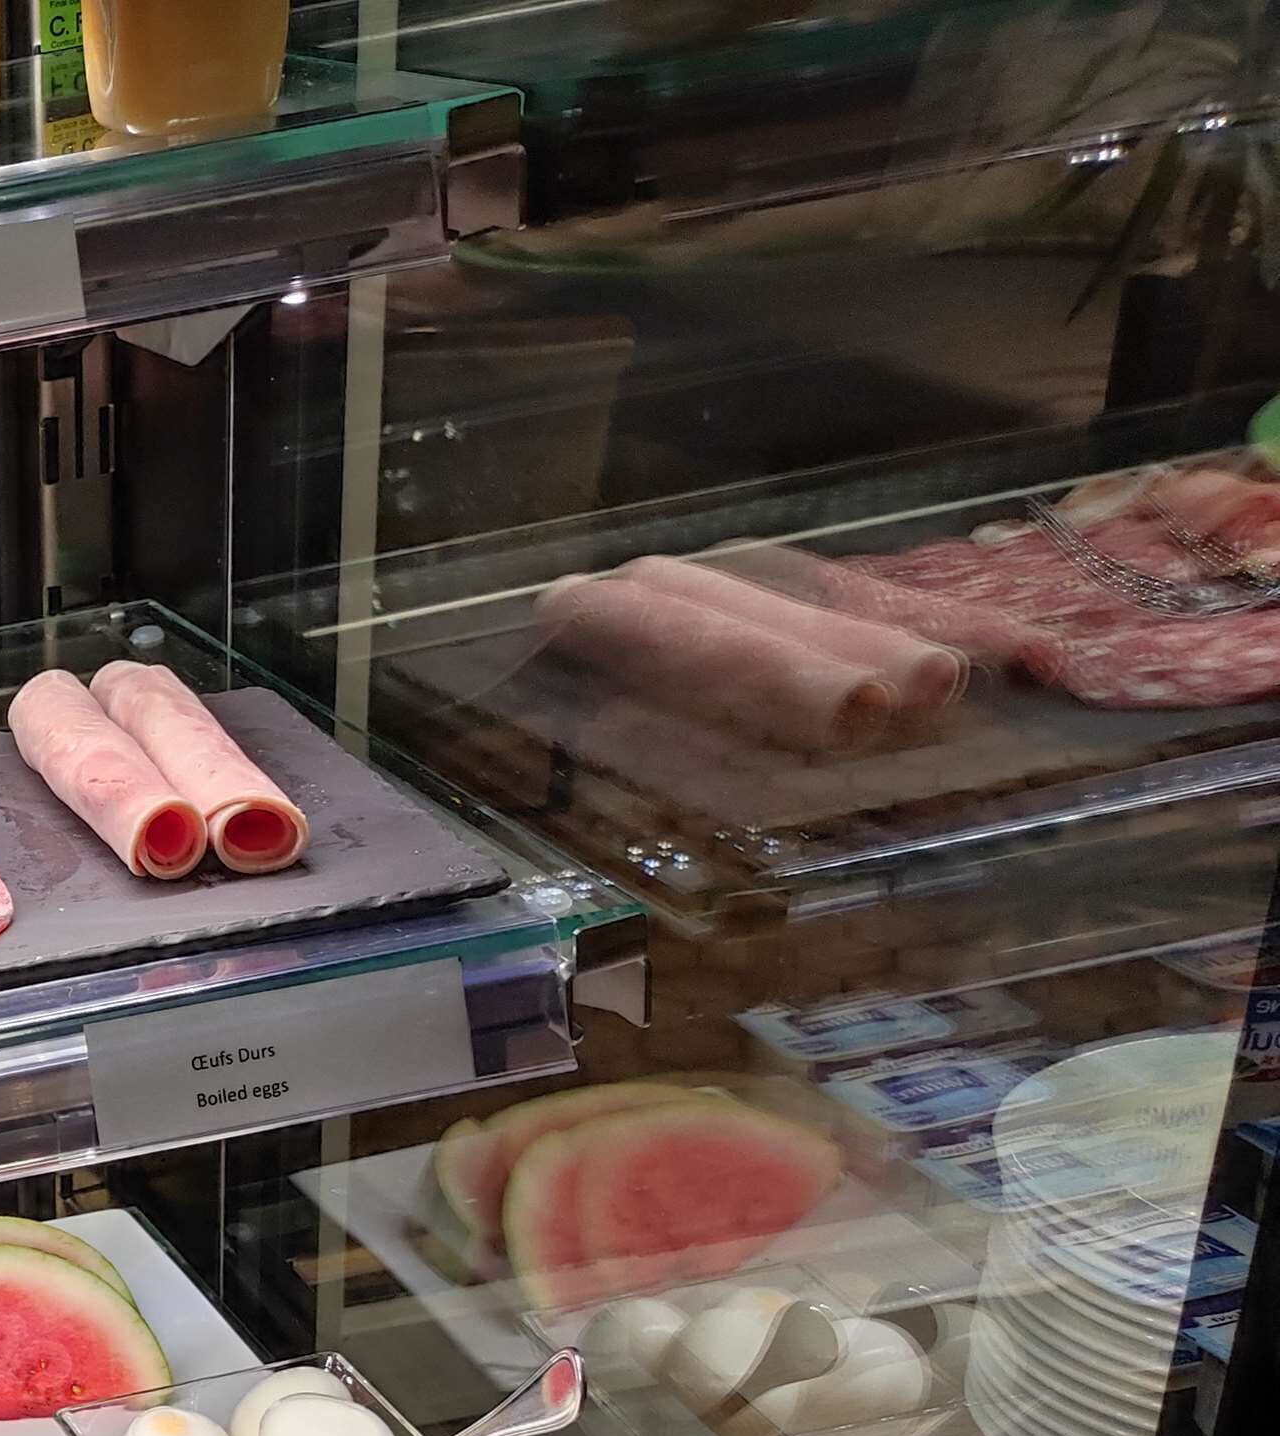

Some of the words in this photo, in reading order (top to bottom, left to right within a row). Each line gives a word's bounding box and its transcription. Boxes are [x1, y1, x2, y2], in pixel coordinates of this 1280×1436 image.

[191, 1049, 234, 1072] Œufs
[238, 1044, 276, 1063] Durs
[197, 1086, 247, 1108] Boiled
[252, 1079, 290, 1101] eggs
